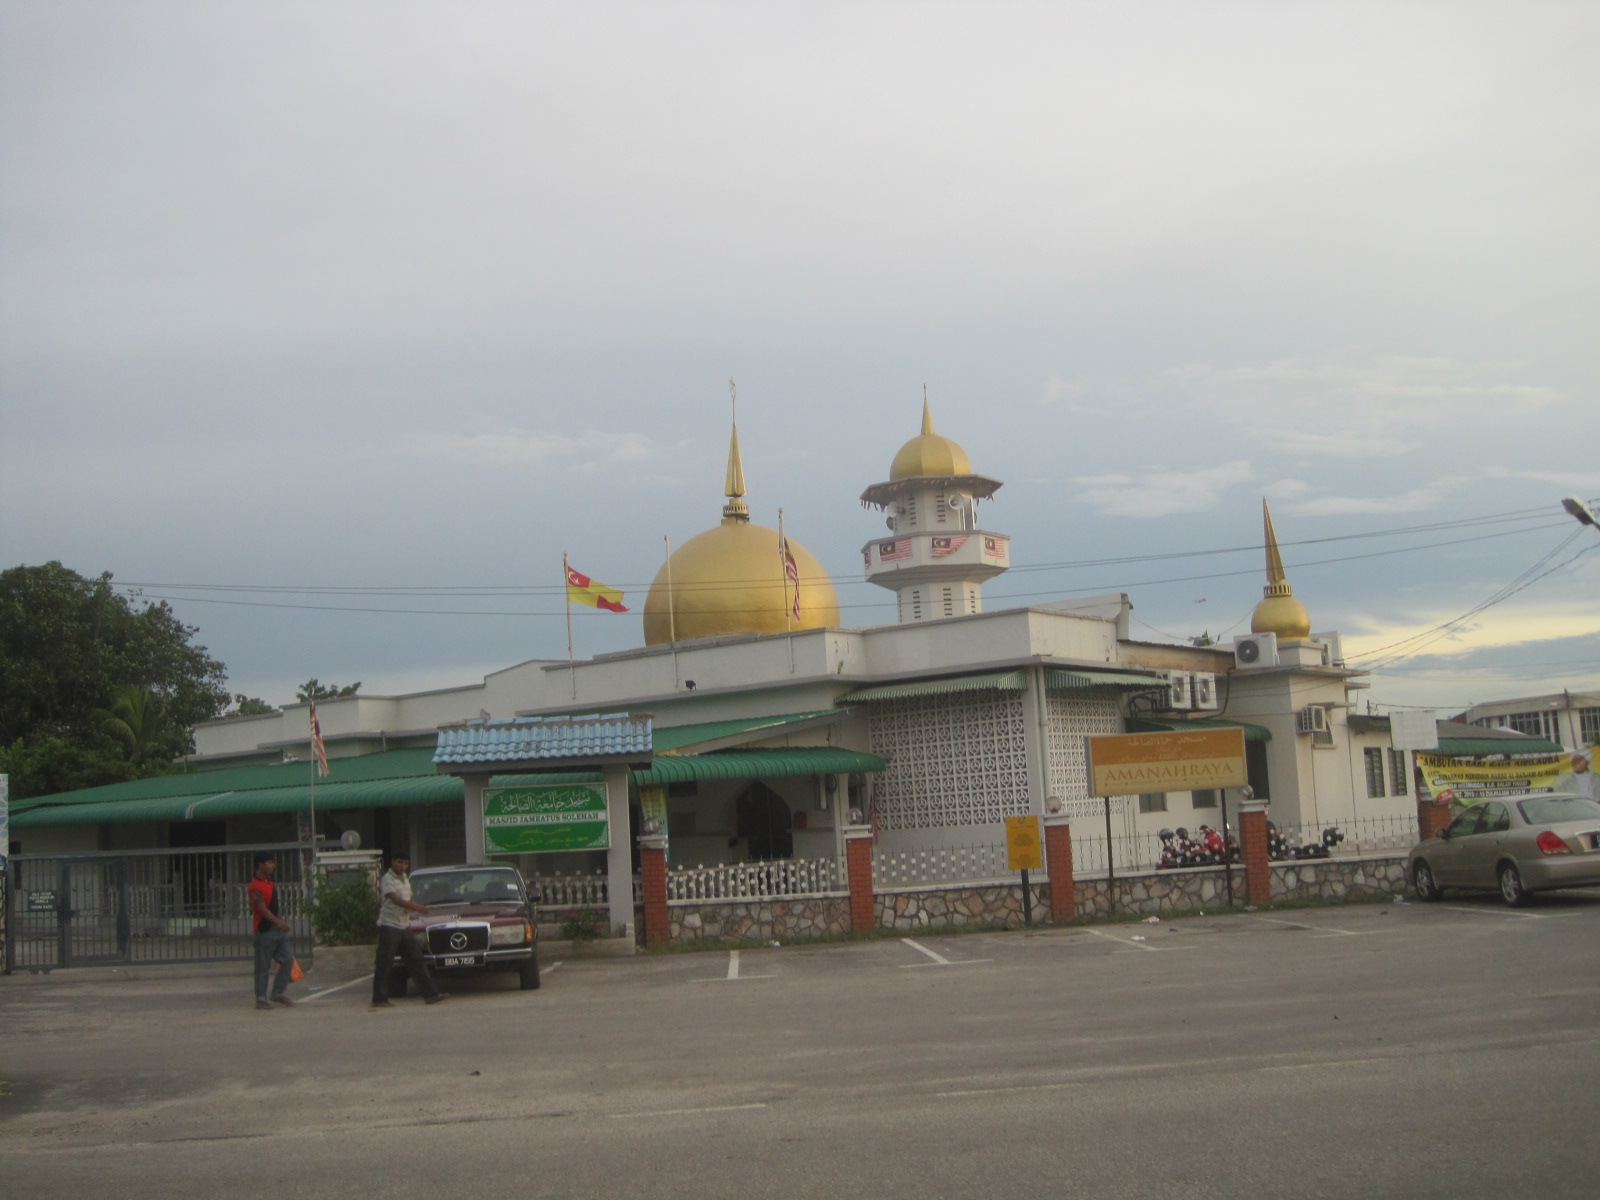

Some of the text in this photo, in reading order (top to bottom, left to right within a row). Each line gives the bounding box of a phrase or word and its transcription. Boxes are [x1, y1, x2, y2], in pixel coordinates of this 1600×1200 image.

[1105, 762, 1233, 782] AMANAHRAYA
[488, 812, 600, 825] MASJID JAMEATUS SOLEHAH
[444, 958, 459, 966] BBA
